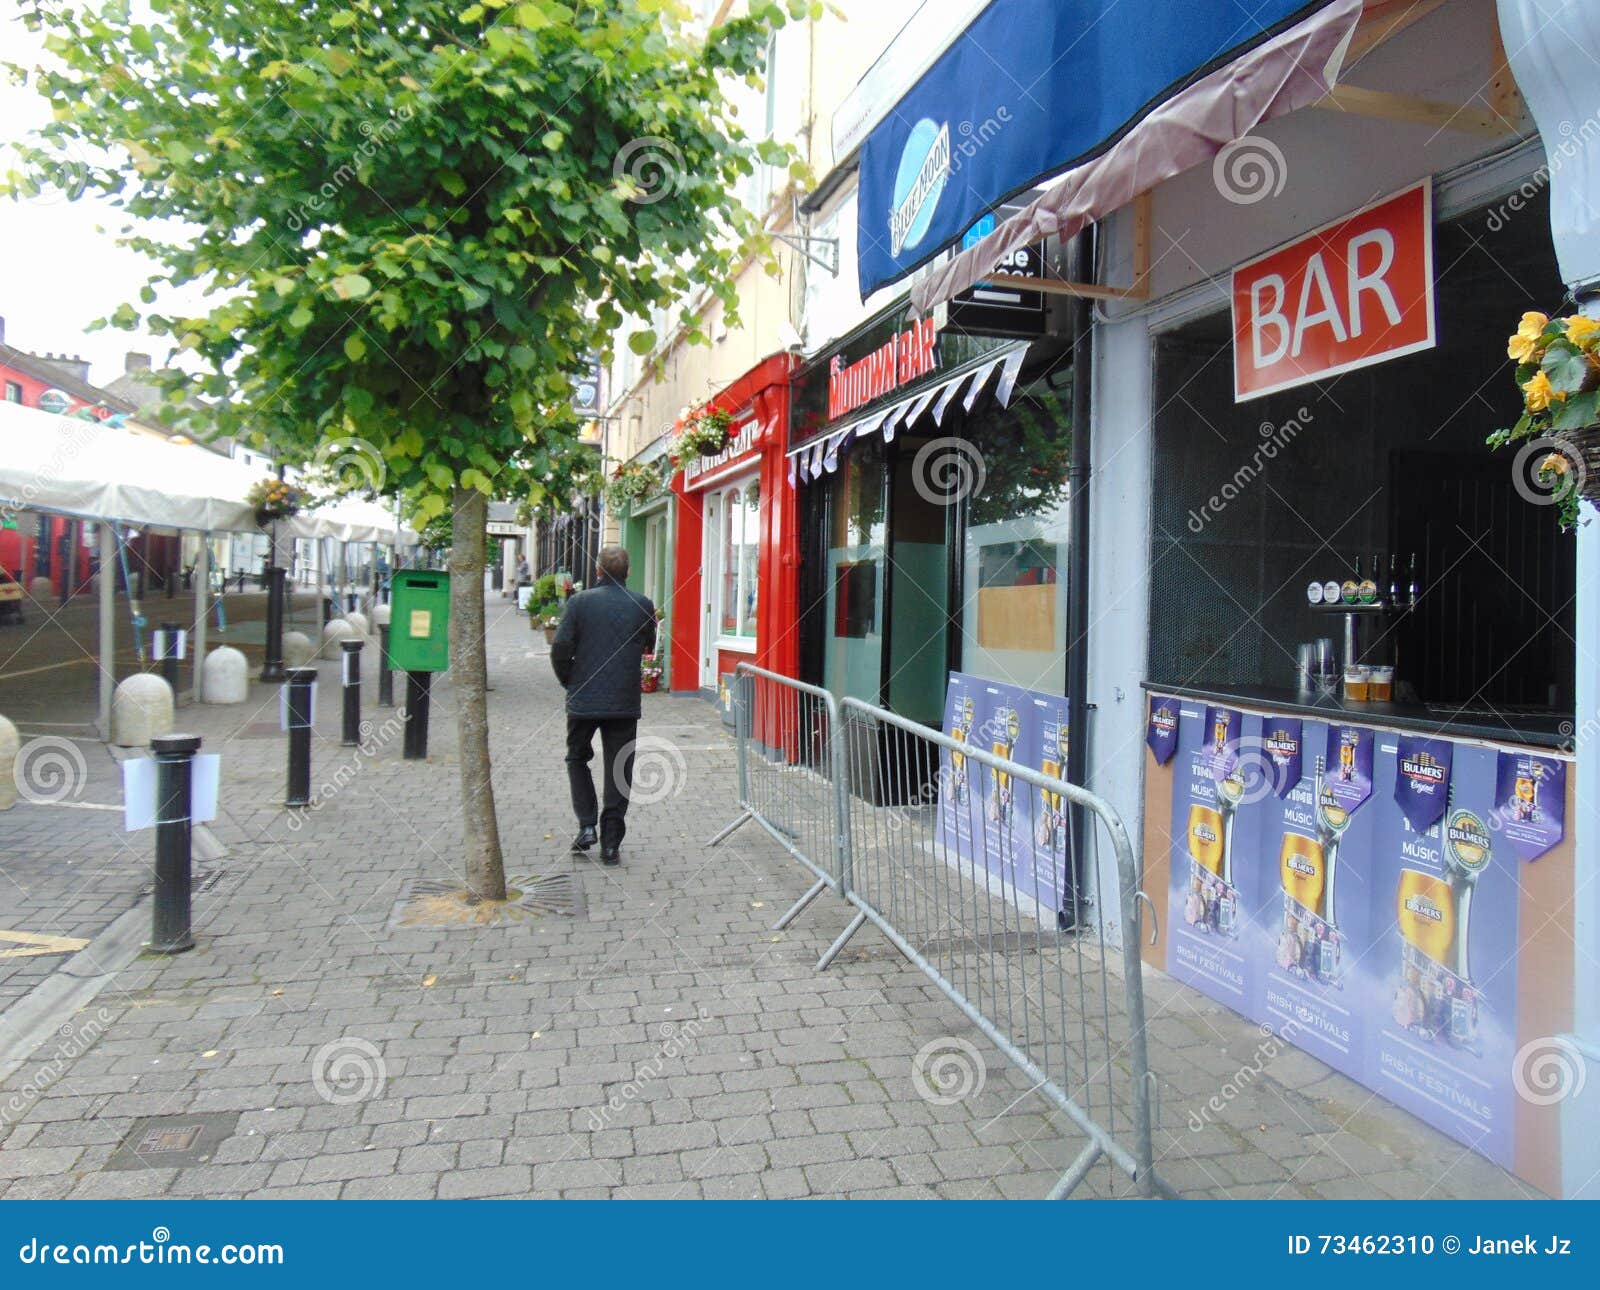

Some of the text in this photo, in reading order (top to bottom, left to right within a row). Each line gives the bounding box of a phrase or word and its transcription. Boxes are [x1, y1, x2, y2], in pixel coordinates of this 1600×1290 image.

[918, 130, 948, 201] MOON
[1251, 228, 1402, 369] BAR
[828, 316, 936, 420] MOTOWN BAR
[1402, 761, 1444, 780] BULMERS
[1191, 783, 1214, 799] MUSIC
[1284, 808, 1313, 826] MUSIC
[1402, 841, 1439, 863] MUSIC
[1449, 828, 1490, 850] BULMERS
[1406, 900, 1441, 920] BULMERS
[1177, 945, 1197, 963] IRISH
[1199, 954, 1244, 985] FESTIVALS
[1267, 990, 1293, 1012] IRISH
[1296, 1006, 1350, 1042] FESTIVALS
[1381, 1051, 1415, 1079] IRISH
[1418, 1071, 1492, 1119] FESTIVALS
